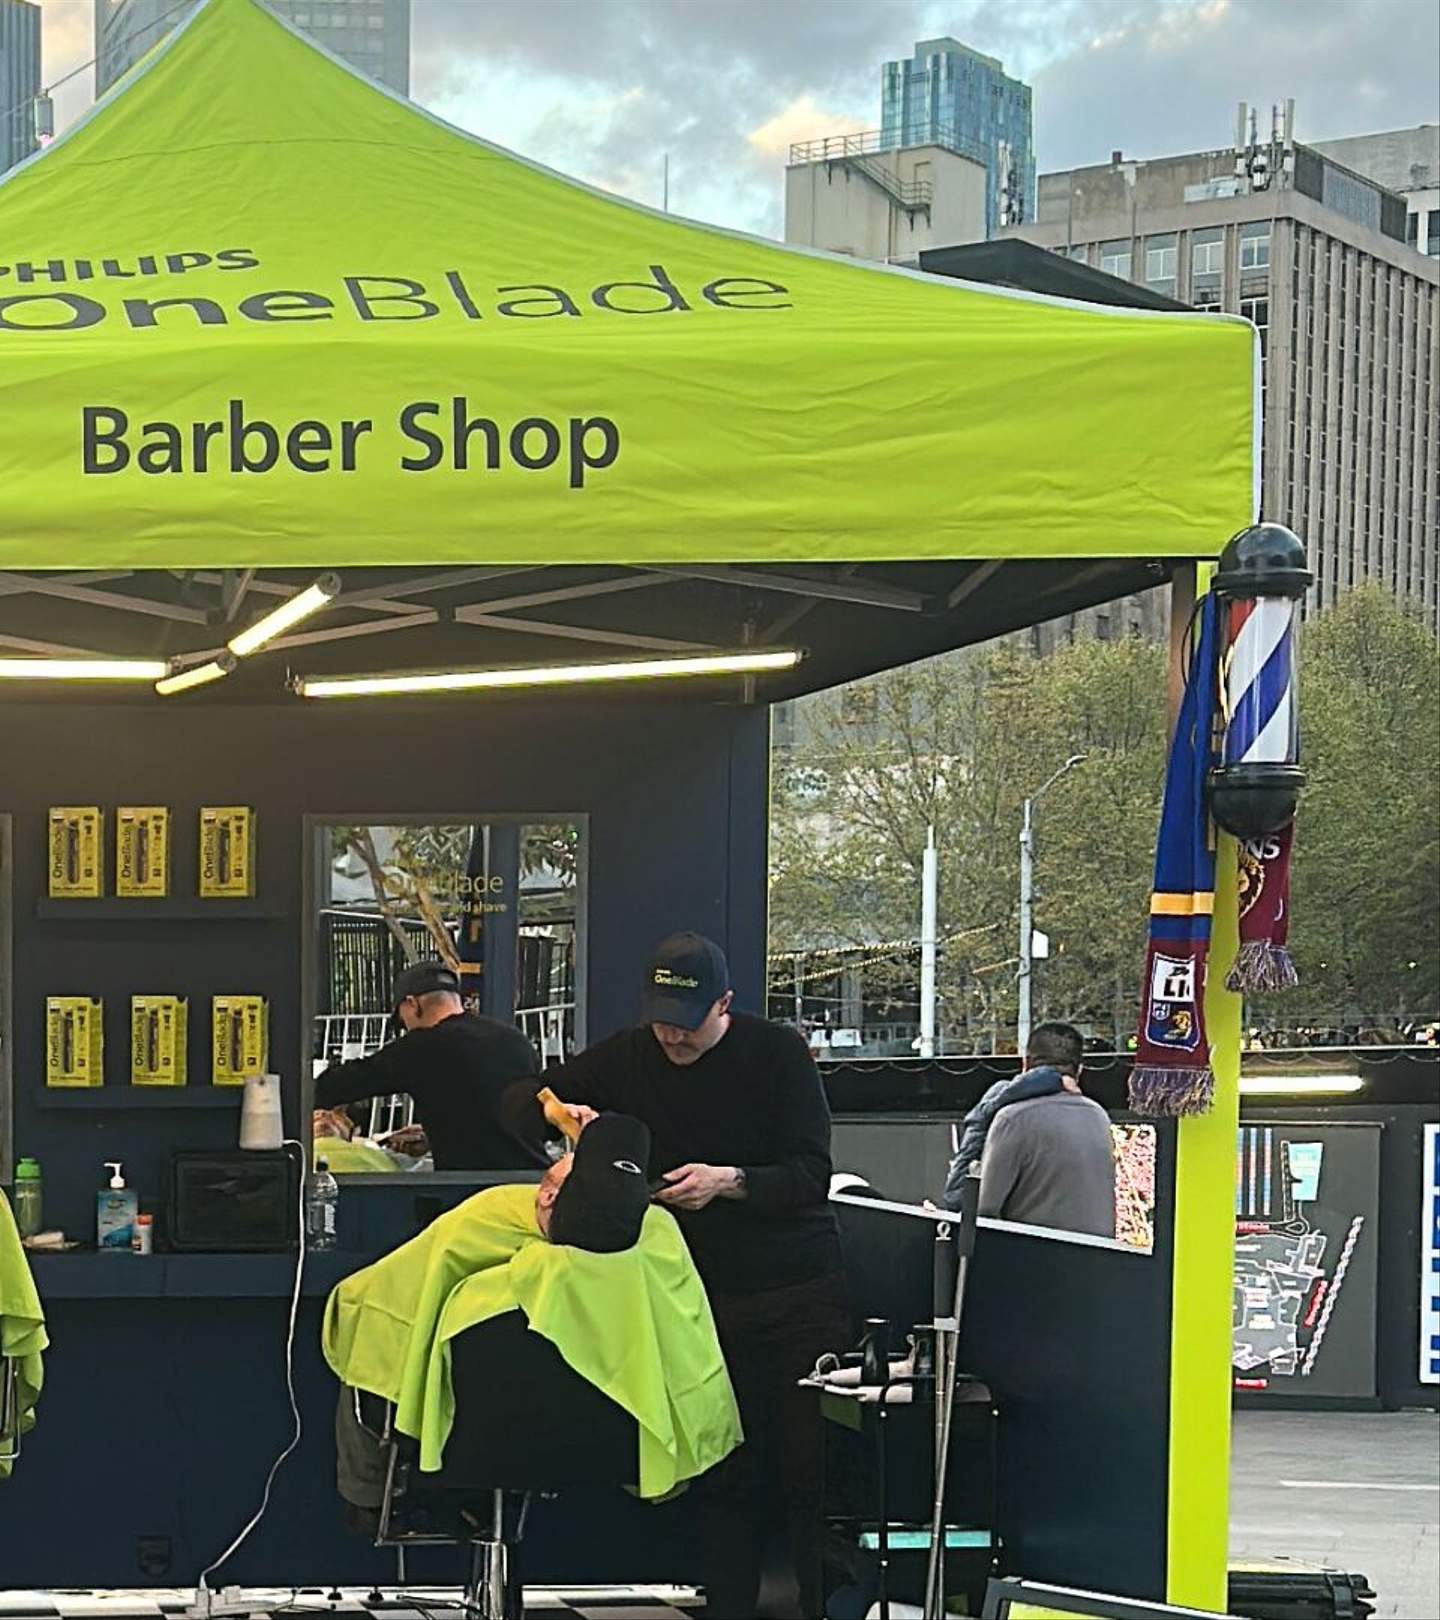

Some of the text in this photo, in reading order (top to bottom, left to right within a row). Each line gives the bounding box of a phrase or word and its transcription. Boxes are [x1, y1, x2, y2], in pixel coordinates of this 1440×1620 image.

[82, 397, 620, 488] Barber Shop
[1239, 834, 1281, 860] NS
